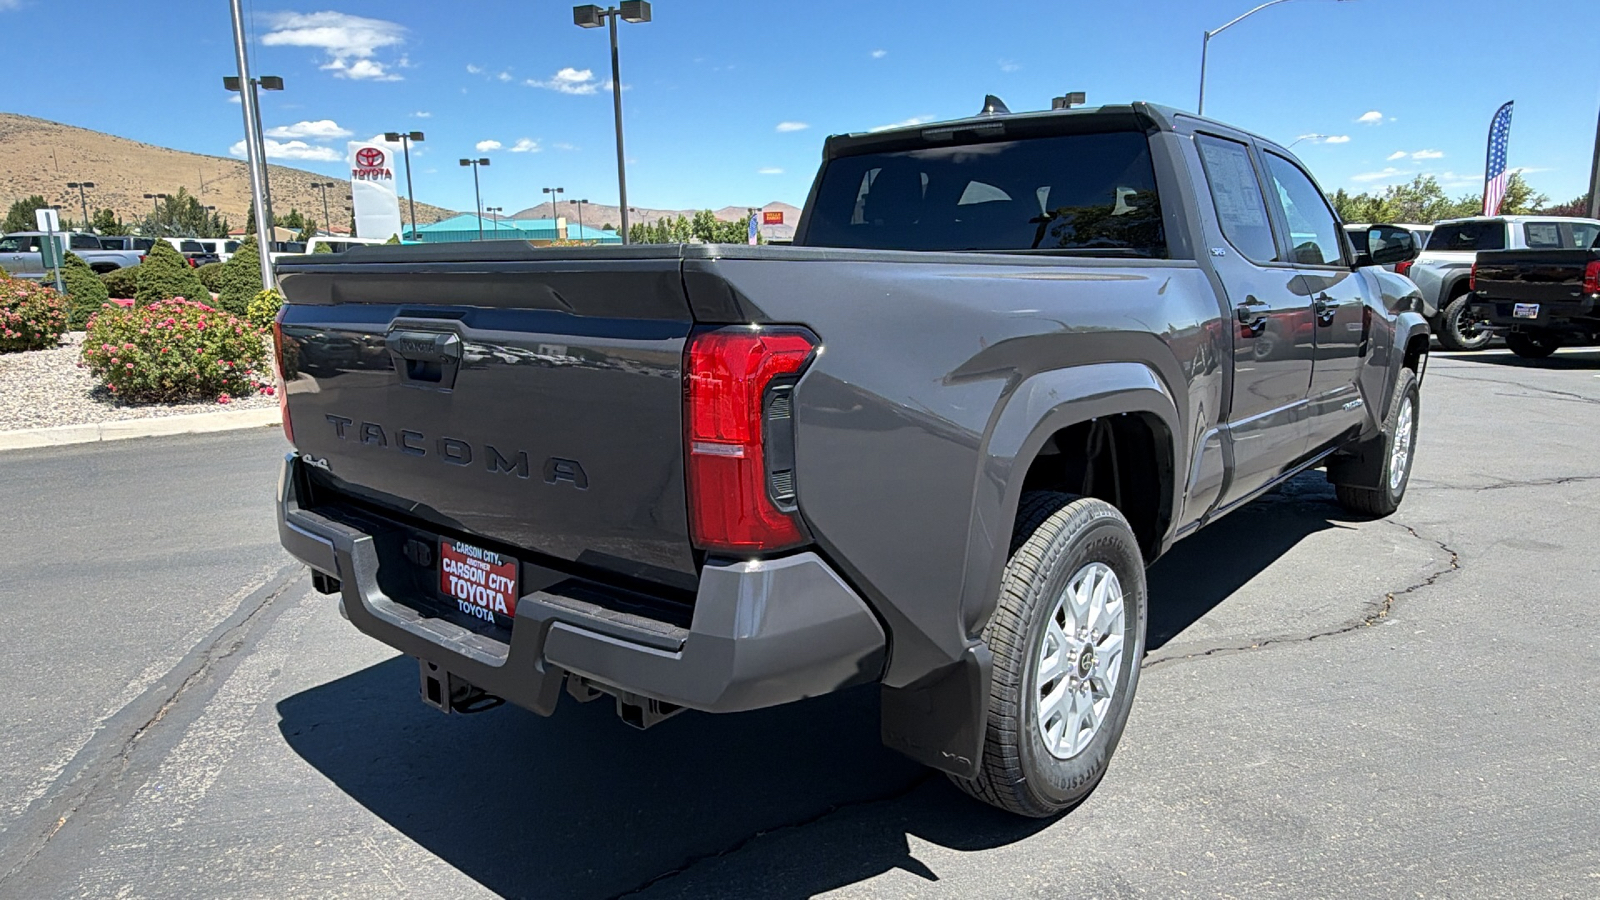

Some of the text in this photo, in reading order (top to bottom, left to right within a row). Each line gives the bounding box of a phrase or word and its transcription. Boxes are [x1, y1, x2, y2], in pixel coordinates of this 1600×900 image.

[352, 168, 392, 179] TOYOTA
[325, 414, 589, 490] TACOMA
[456, 541, 499, 565] CARSON CITY
[466, 557, 491, 571] ANOTHER
[442, 557, 515, 595] CARSON CITY
[449, 575, 509, 615] TOYOTA
[457, 599, 496, 624] TOYOTA
